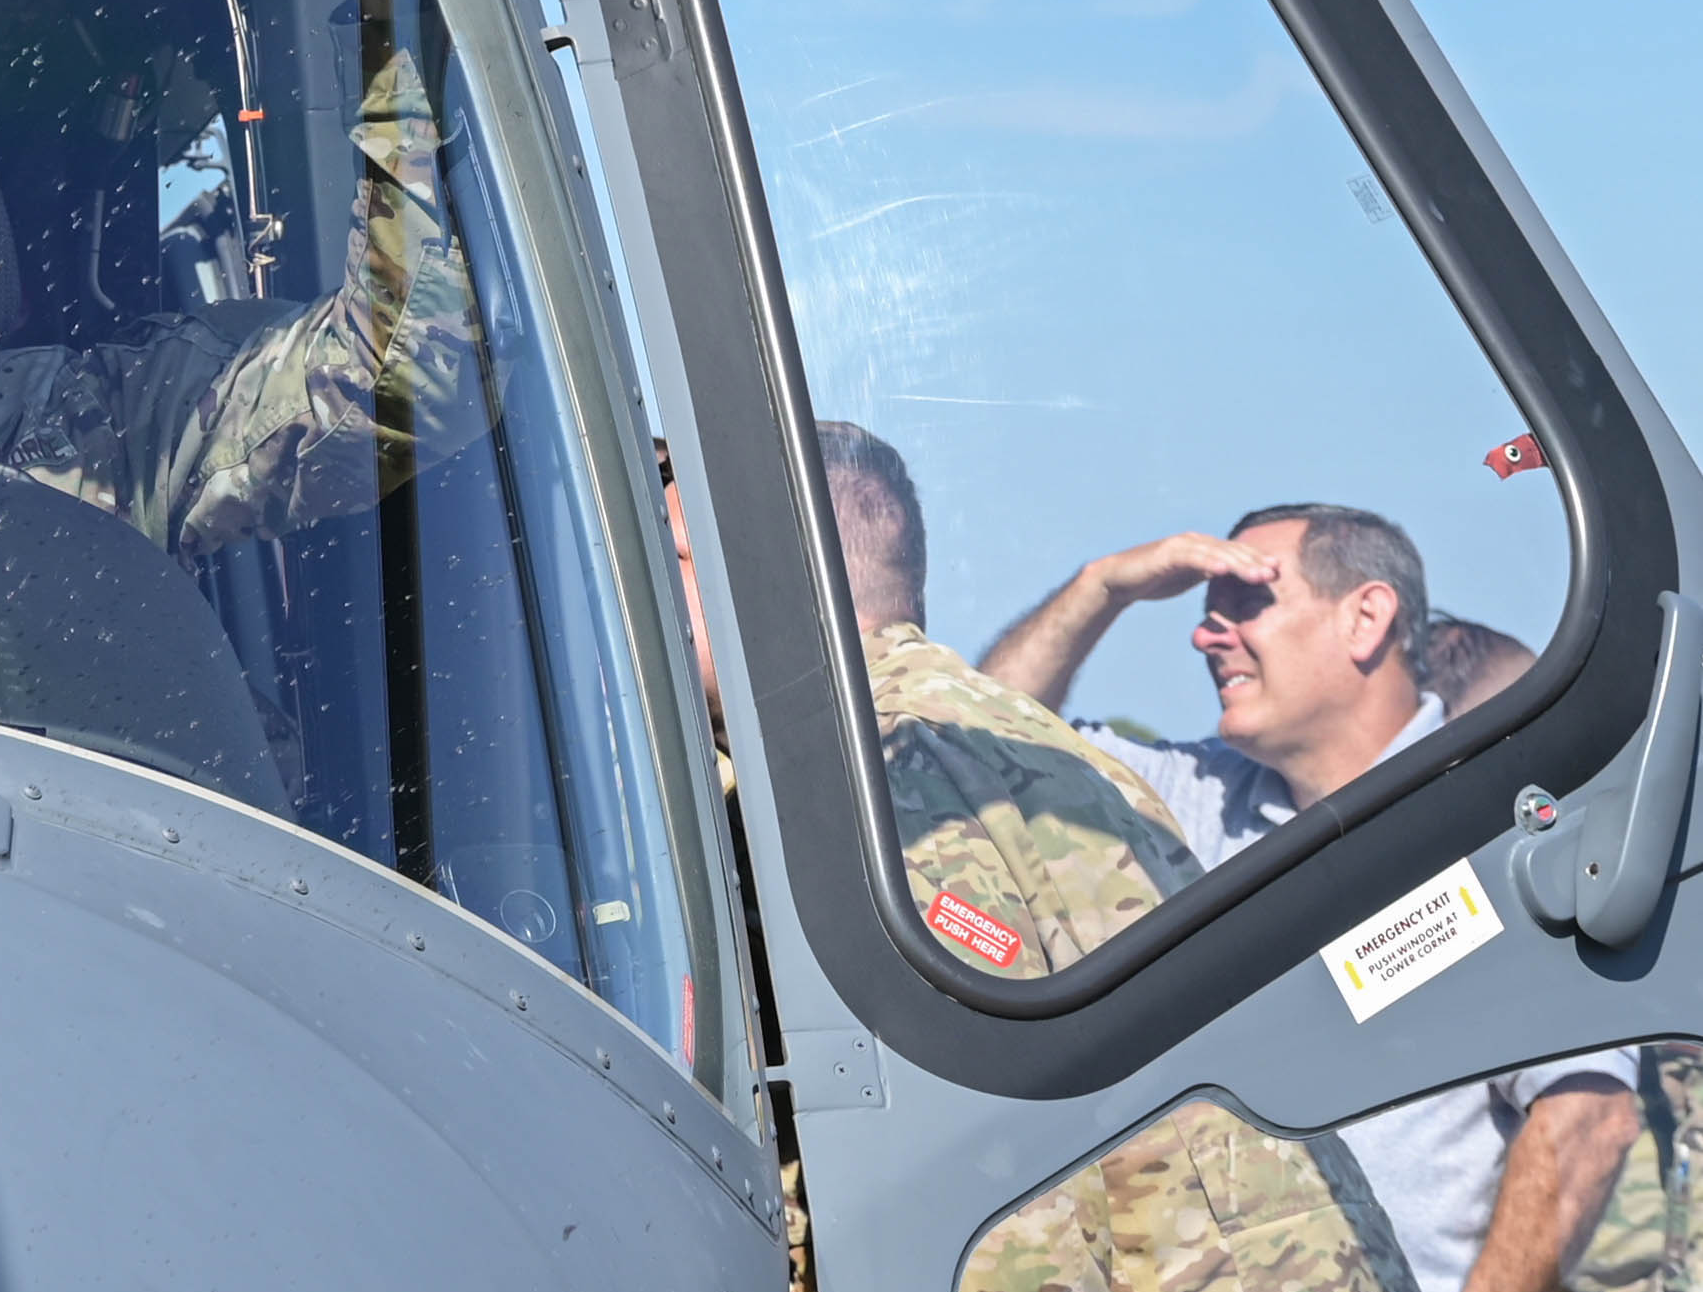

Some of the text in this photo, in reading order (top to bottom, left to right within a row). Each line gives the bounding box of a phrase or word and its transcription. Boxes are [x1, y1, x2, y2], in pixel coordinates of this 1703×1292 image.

[934, 914, 1005, 963] PUSH HERE
[940, 895, 1017, 946] EMERGENCY
[1355, 891, 1451, 960] EMERGENCY EXIT
[1368, 912, 1458, 975] PUSH WINDOW AT
[1381, 927, 1458, 981] LOWER CORNER
